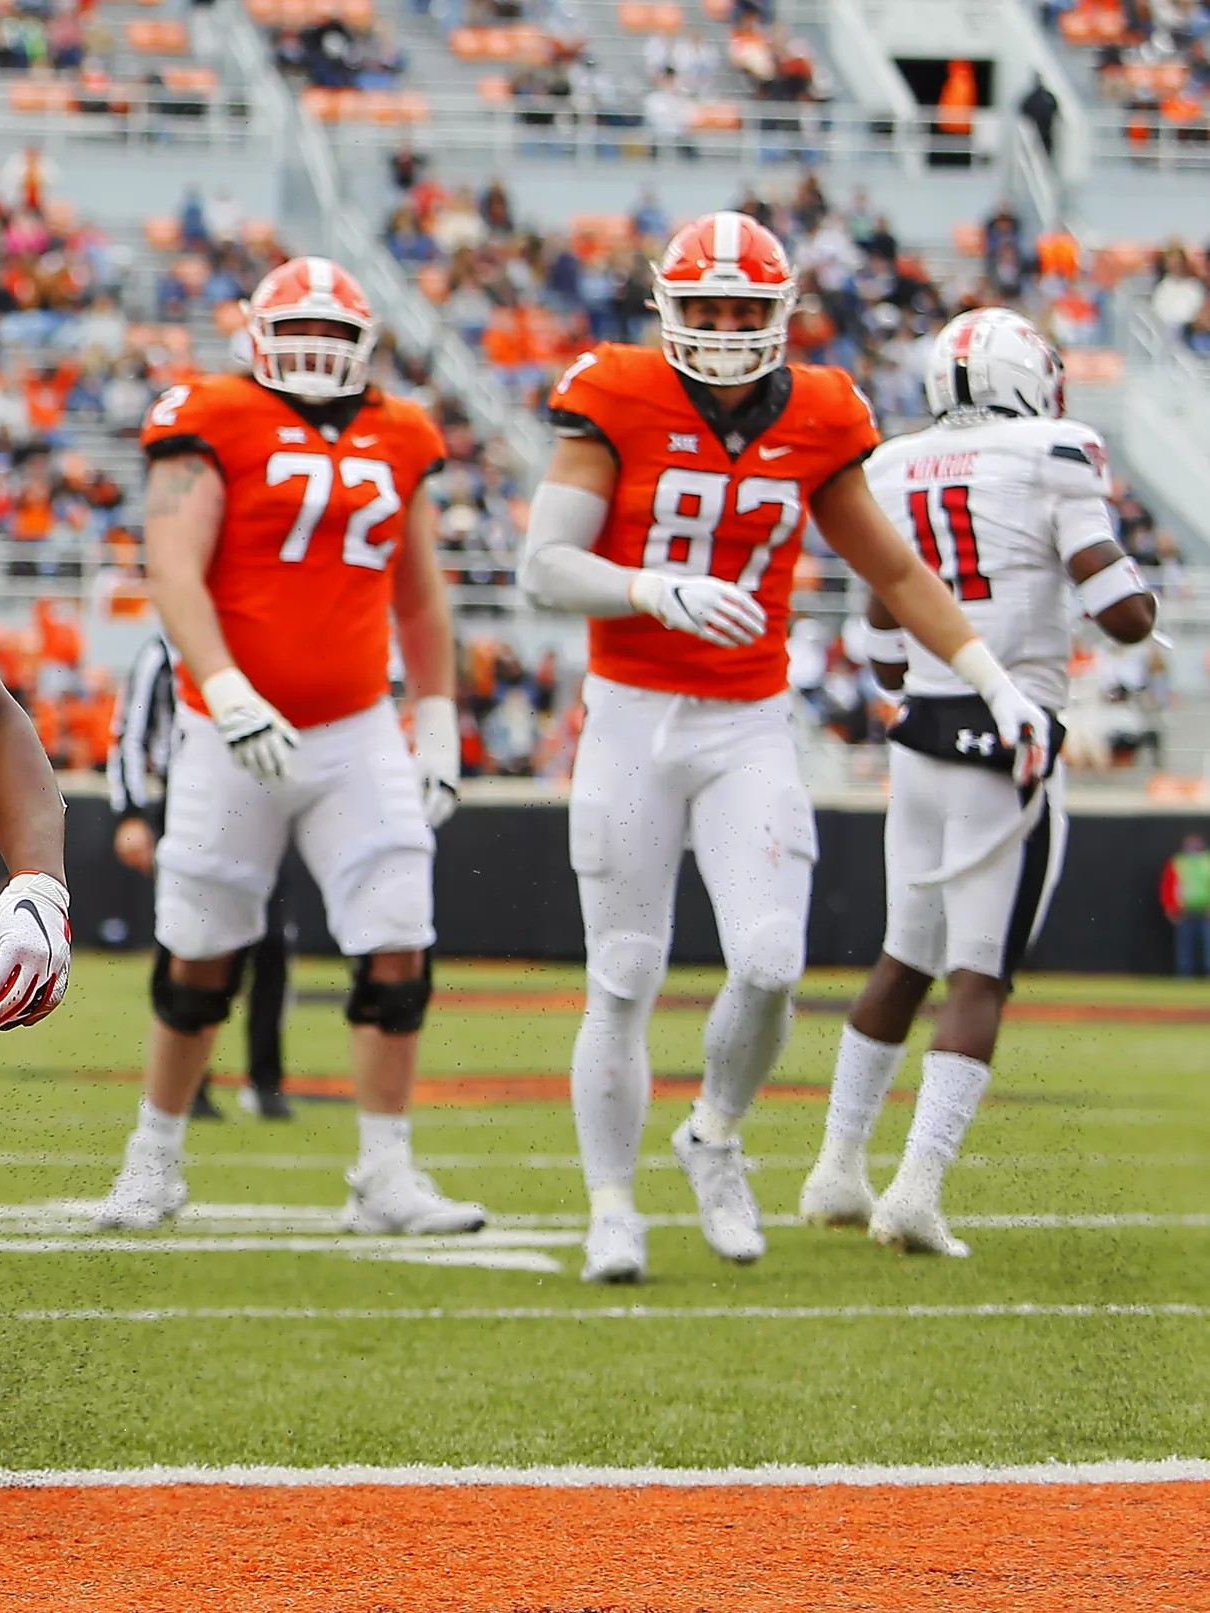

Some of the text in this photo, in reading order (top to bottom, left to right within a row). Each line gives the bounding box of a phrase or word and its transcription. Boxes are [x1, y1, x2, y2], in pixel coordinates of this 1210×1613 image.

[266, 451, 402, 572] 72
[643, 467, 802, 593] 87
[907, 485, 992, 601] 11
